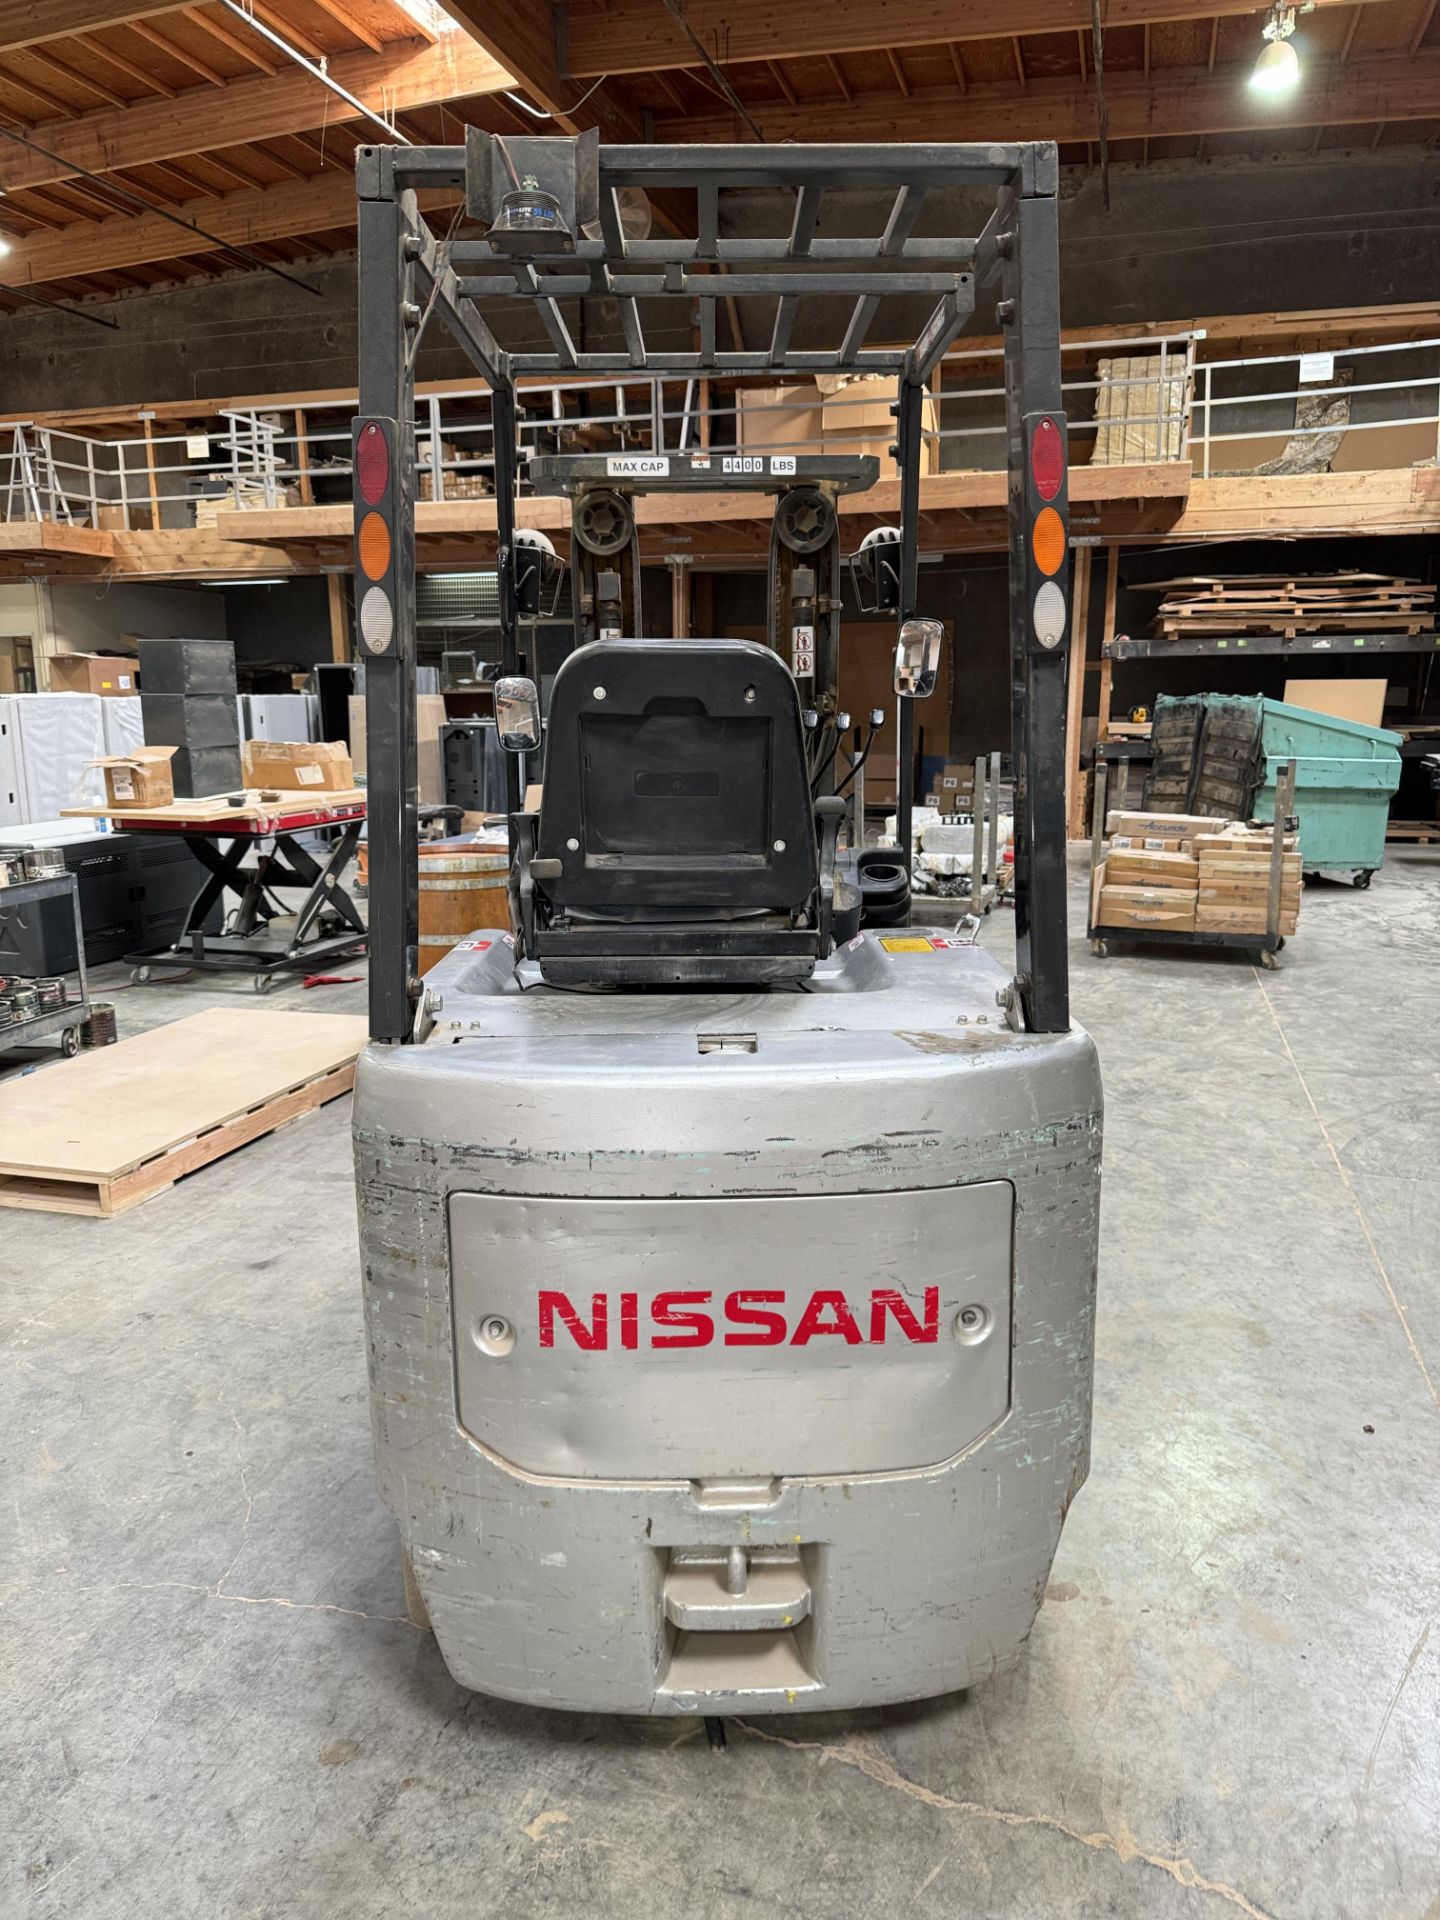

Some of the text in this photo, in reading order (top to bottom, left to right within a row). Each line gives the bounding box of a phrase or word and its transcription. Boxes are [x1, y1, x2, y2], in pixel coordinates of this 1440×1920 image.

[612, 460, 794, 472] MAX CAP 4400 LBS
[538, 1285, 939, 1351] NISSAN
